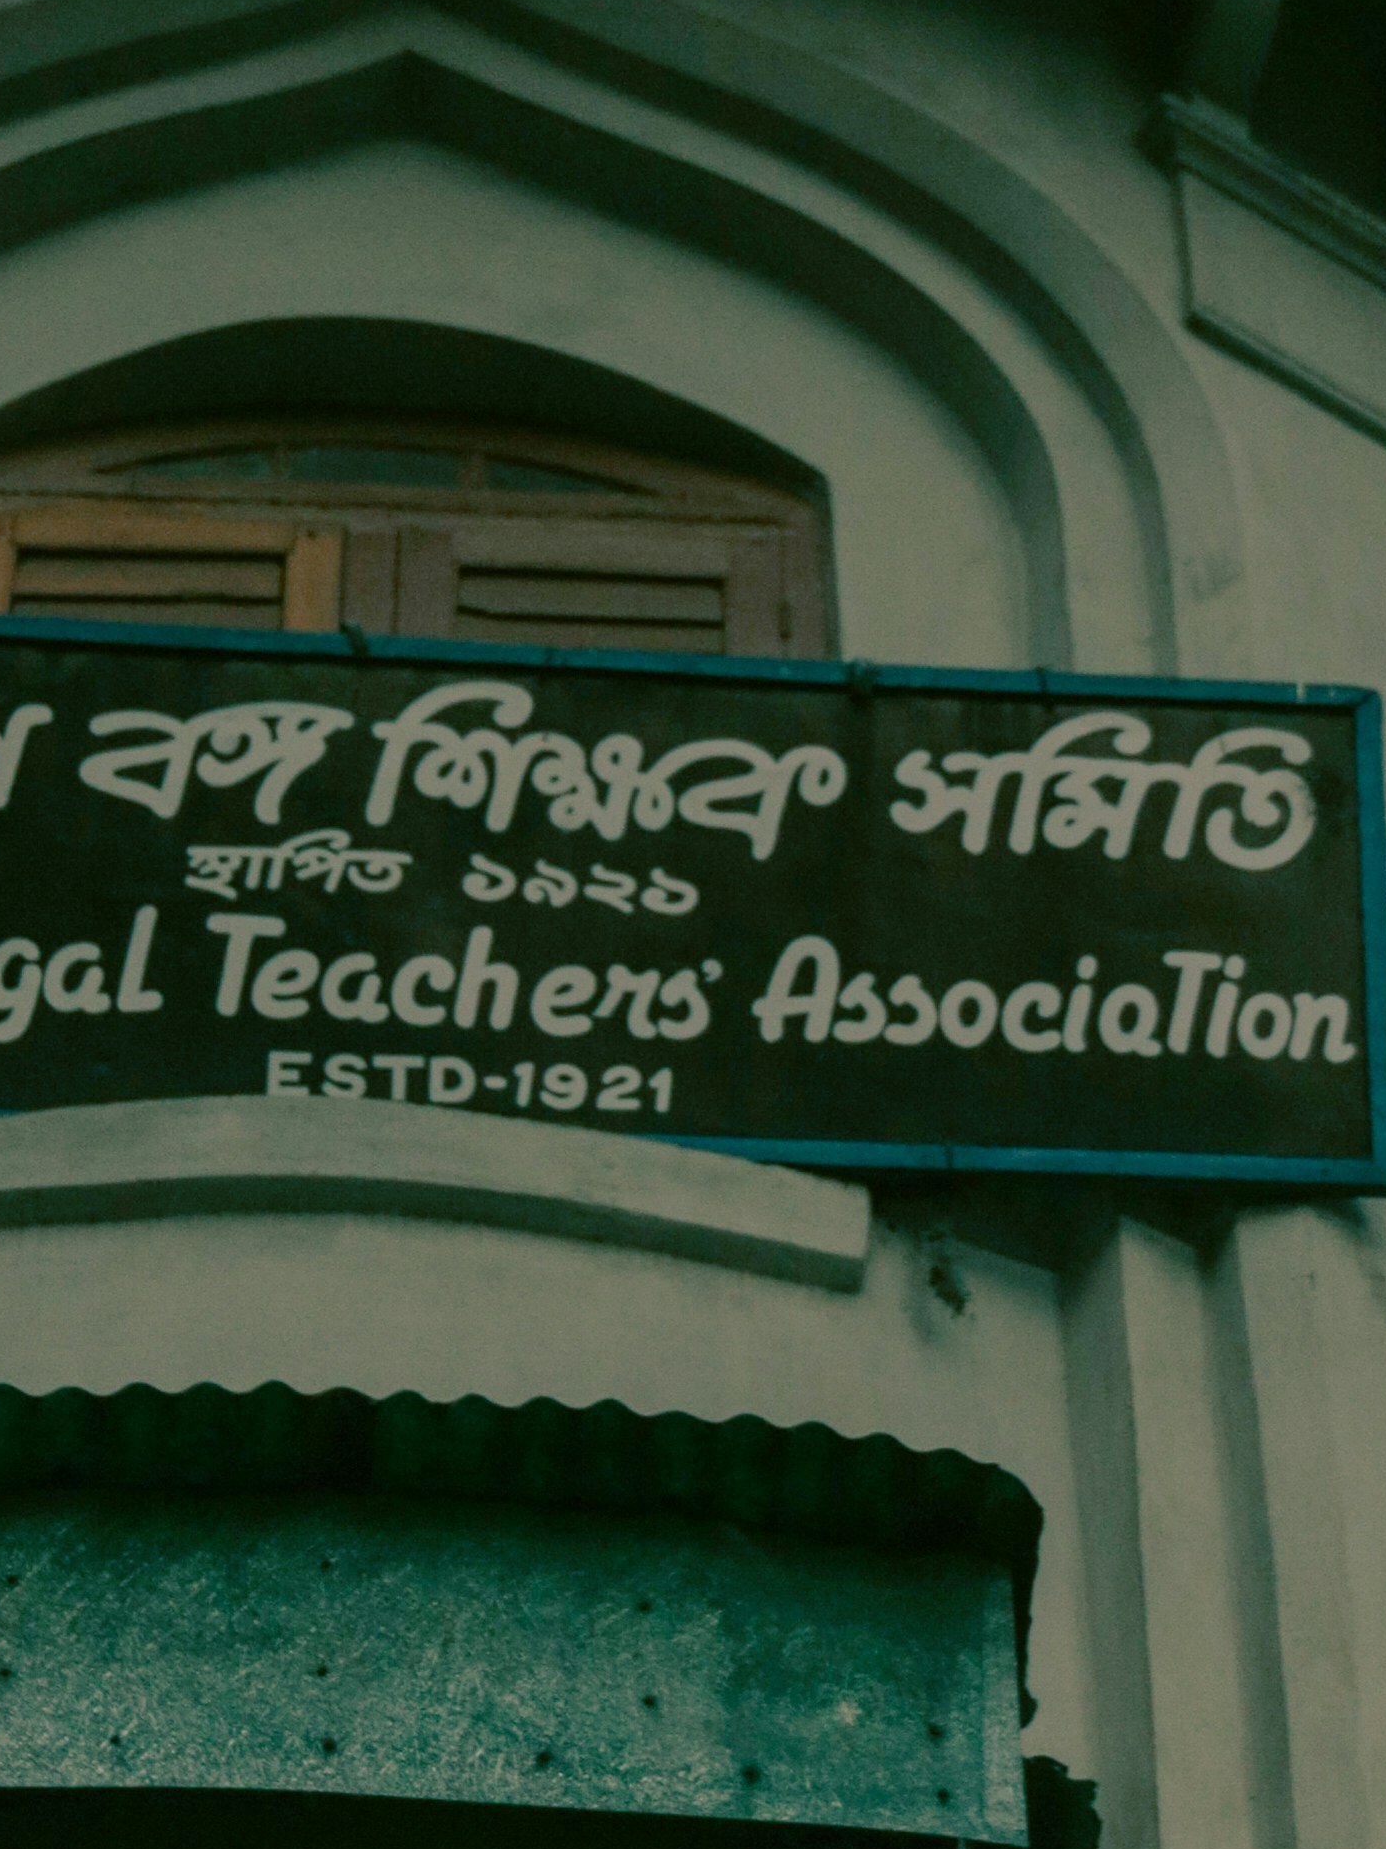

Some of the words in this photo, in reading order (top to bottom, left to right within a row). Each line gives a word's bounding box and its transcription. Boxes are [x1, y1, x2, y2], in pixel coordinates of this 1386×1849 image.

[77, 700, 356, 826] বঙ্গ
[363, 678, 848, 862] শিক্ষক
[888, 708, 1318, 874] সমিতি
[184, 828, 414, 901] স্থাপিত
[461, 853, 700, 917] ১৯২১
[266, 1050, 674, 1114] ESTD-1921
